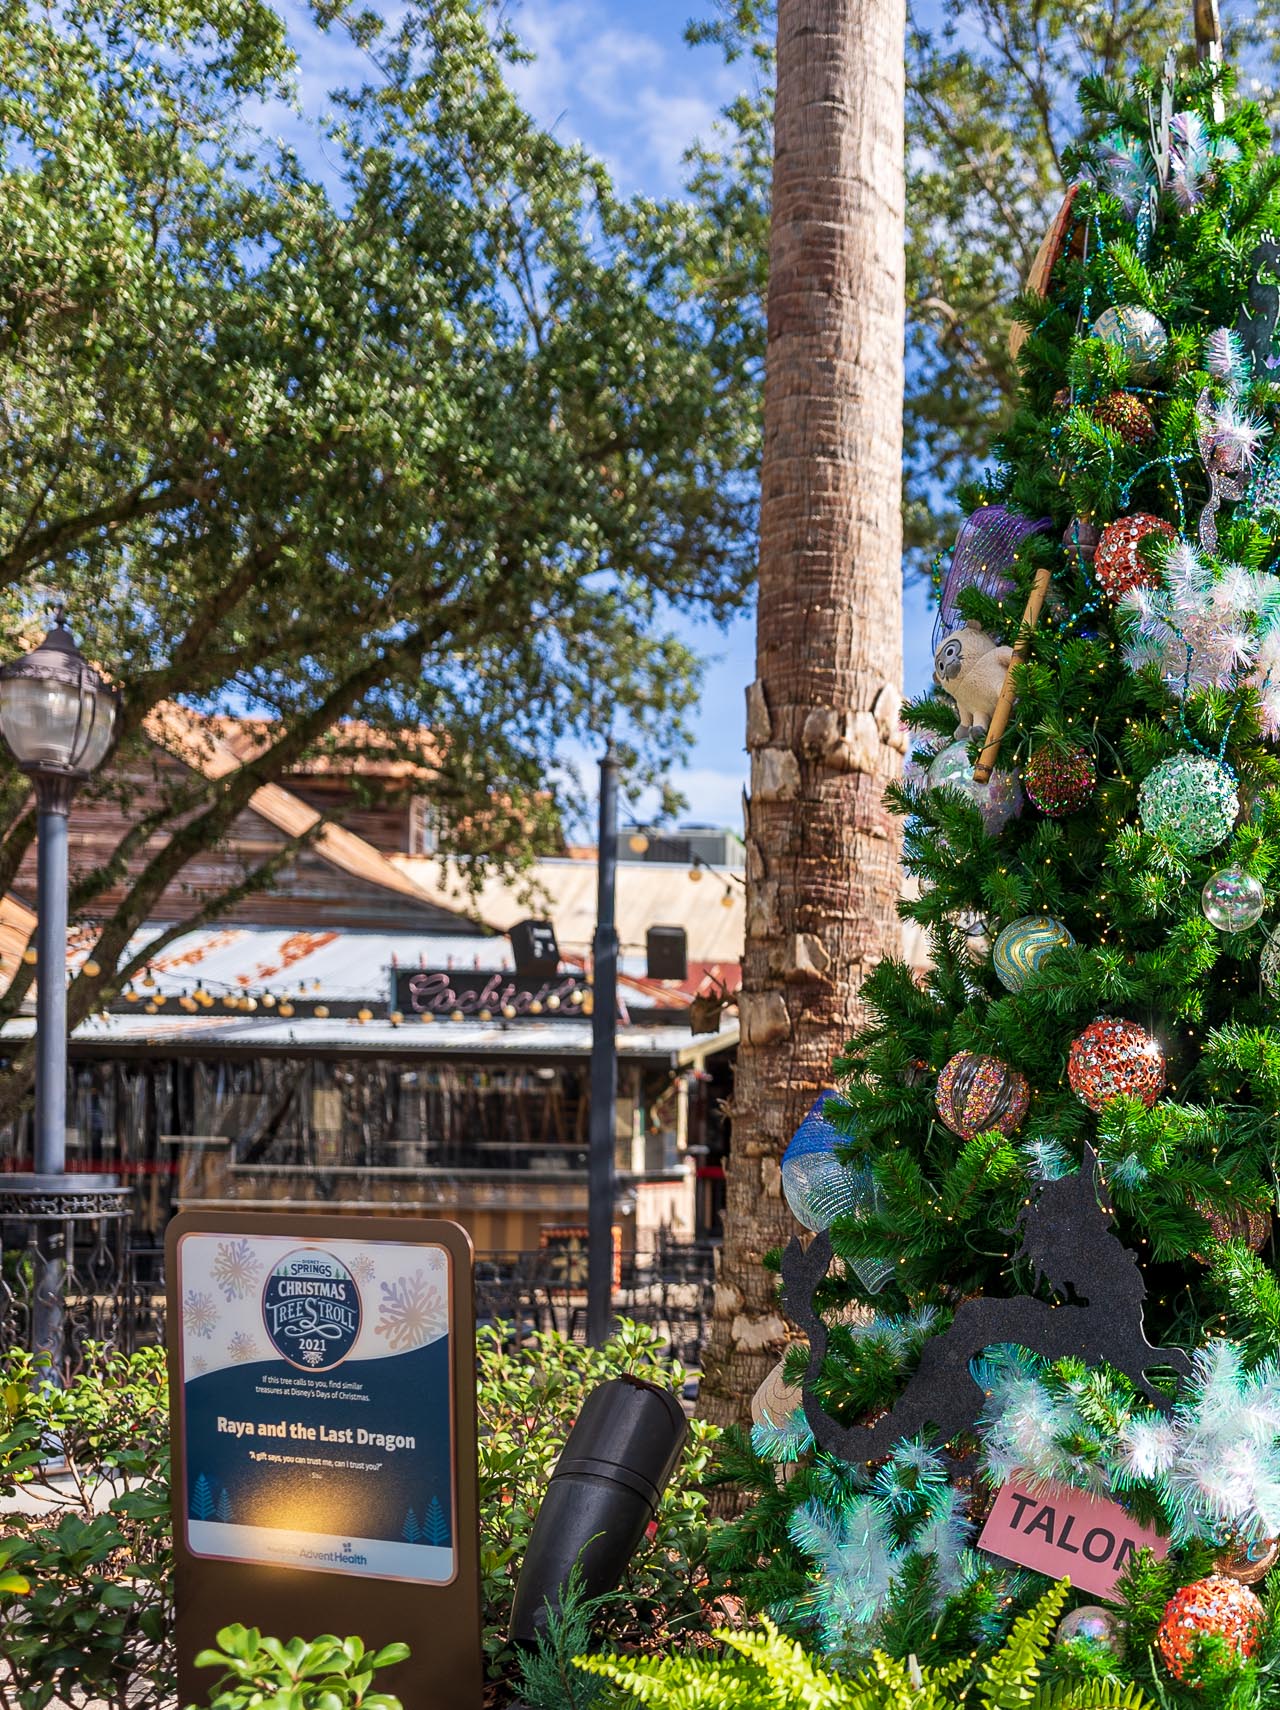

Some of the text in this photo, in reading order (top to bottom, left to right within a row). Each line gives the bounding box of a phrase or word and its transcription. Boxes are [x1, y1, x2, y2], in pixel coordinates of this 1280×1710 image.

[291, 1264, 332, 1278] SPRINGS
[278, 1280, 346, 1301] CHRISTMAS
[299, 1338, 327, 1351] 2021
[262, 1375, 363, 1390] If this tree calls to you, find similar
[256, 1386, 283, 1395] treasures
[291, 1388, 316, 1398] Disney's
[316, 1390, 331, 1400] Days
[331, 1391, 339, 1399] of
[217, 1416, 416, 1452] Raya and the Last Dragon
[282, 1456, 295, 1464] you
[295, 1456, 306, 1464] can
[306, 1457, 322, 1466] trust
[334, 1460, 346, 1468] can
[349, 1461, 365, 1470] trust
[299, 1548, 368, 1566] AdventHealth
